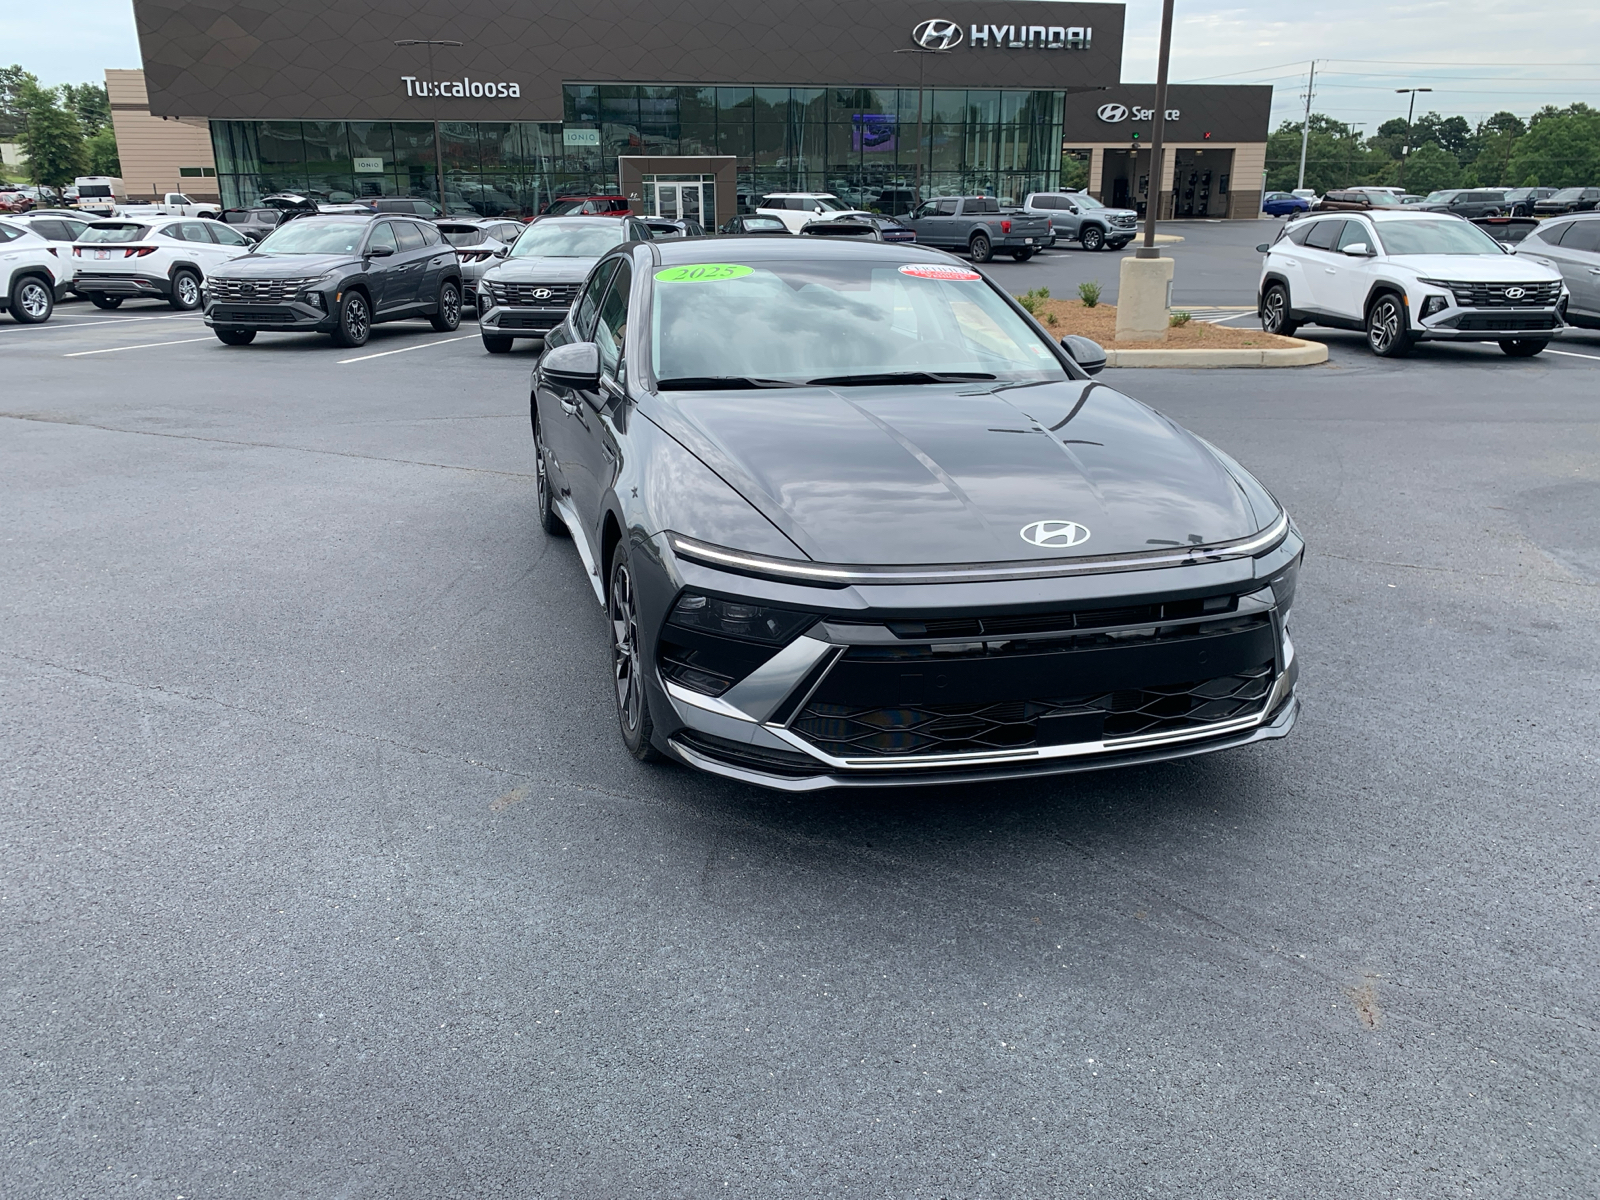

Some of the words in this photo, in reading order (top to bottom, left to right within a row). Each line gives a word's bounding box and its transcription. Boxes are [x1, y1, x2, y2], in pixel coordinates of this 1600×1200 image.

[970, 24, 1093, 49] HYUNDAI
[400, 76, 521, 98] Tuscaloosa
[1131, 106, 1181, 121] Serce
[671, 266, 737, 281] 2025
